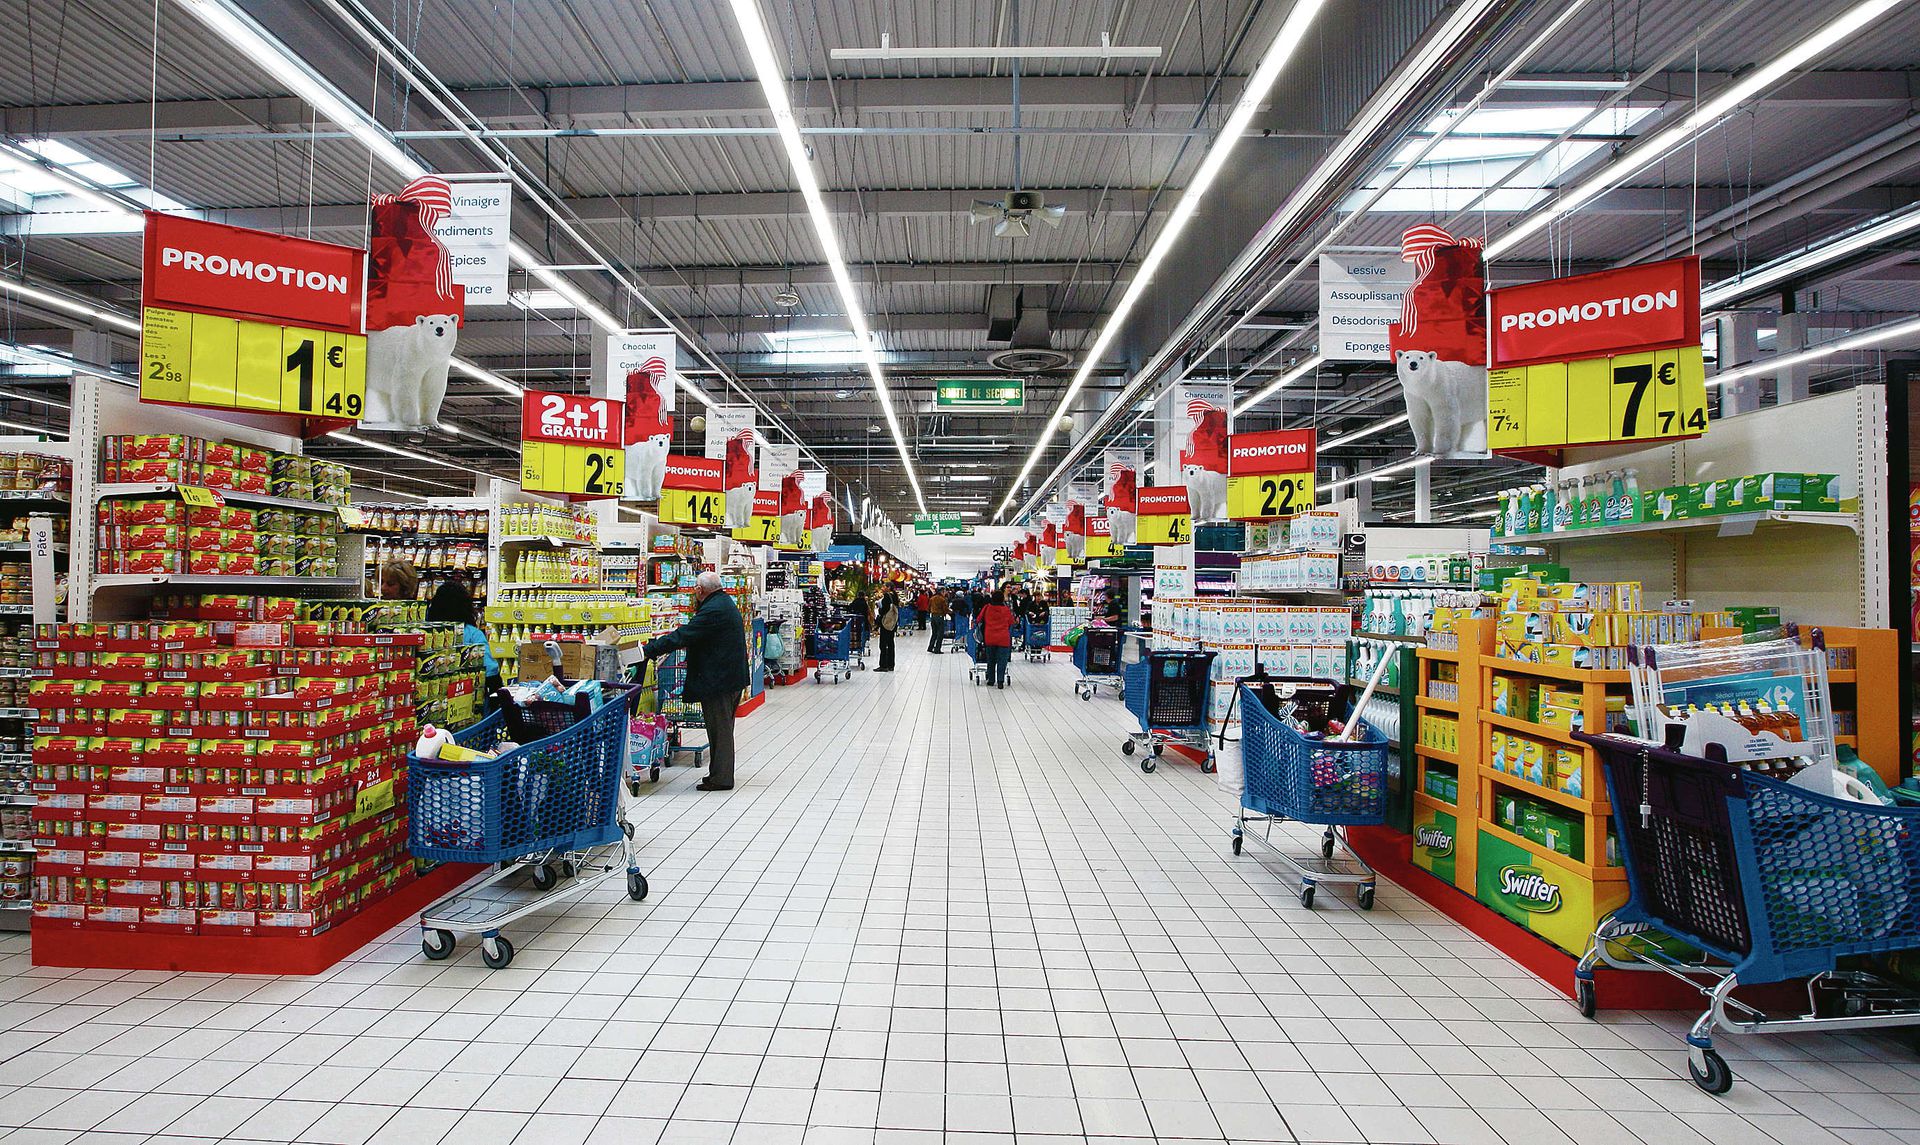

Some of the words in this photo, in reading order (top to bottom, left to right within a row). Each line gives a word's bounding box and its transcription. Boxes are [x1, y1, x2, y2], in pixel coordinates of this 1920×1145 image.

[452, 196, 500, 209] Vinaigre
[431, 225, 493, 236] ondiments
[449, 254, 487, 268] Epices
[162, 247, 348, 295] PROMOTION
[1347, 265, 1387, 275] Lessive
[465, 284, 493, 295] ucre
[1500, 288, 1678, 333] PROMOTION
[1332, 314, 1400, 326] Désodorisan
[622, 342, 656, 351] Chocolat
[1345, 341, 1391, 353] Eponges
[940, 387, 967, 399] SORTIE
[971, 387, 982, 399] DE
[985, 387, 1021, 399] SECOURS
[1184, 391, 1224, 400] Charcuterie
[541, 394, 608, 430] 2+1
[541, 423, 608, 440] GRATUIT
[1233, 443, 1307, 458] PROMOTION
[665, 465, 721, 478] PROMOTION
[1140, 495, 1186, 504] PROMOTION
[915, 513, 931, 522] SORTIE
[938, 513, 961, 522] SECOURS
[38, 530, 47, 557] Pâté
[1416, 826, 1452, 850] Swiffer
[1501, 869, 1559, 902] Swiffer
